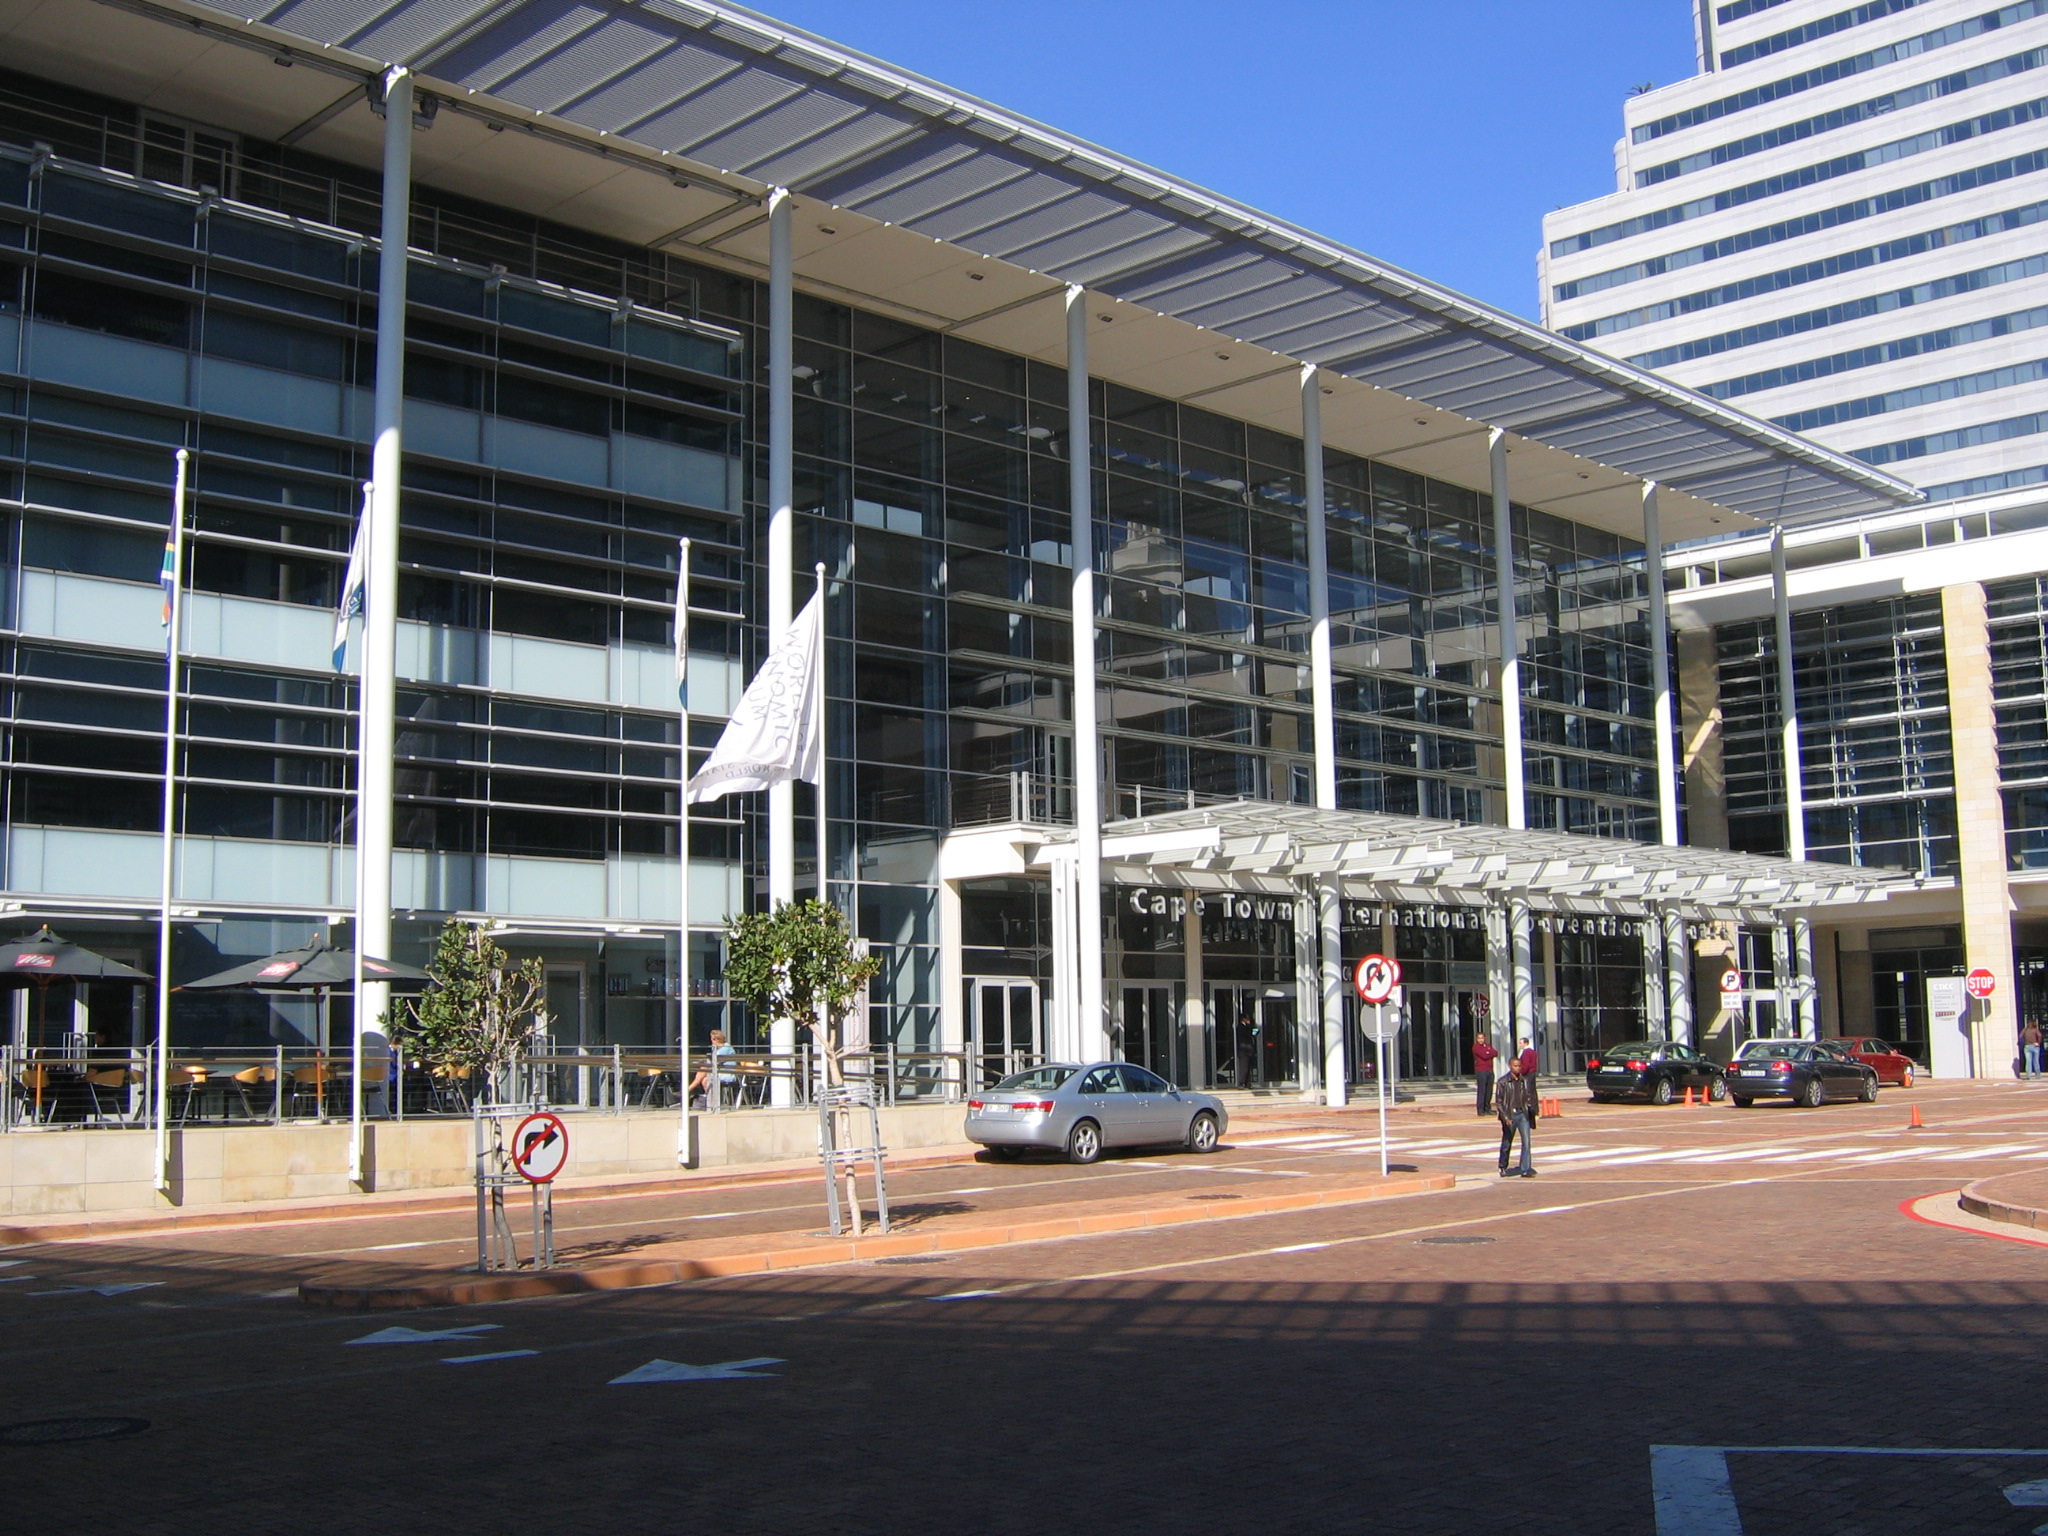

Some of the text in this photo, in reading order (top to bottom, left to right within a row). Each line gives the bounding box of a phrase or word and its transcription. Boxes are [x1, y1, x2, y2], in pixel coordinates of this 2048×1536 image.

[1129, 888, 1206, 922] Cape
[1219, 893, 1292, 921] Town
[1342, 903, 1488, 930] ternational
[1511, 914, 1645, 937] onvention
[1968, 976, 1994, 990] STOP
